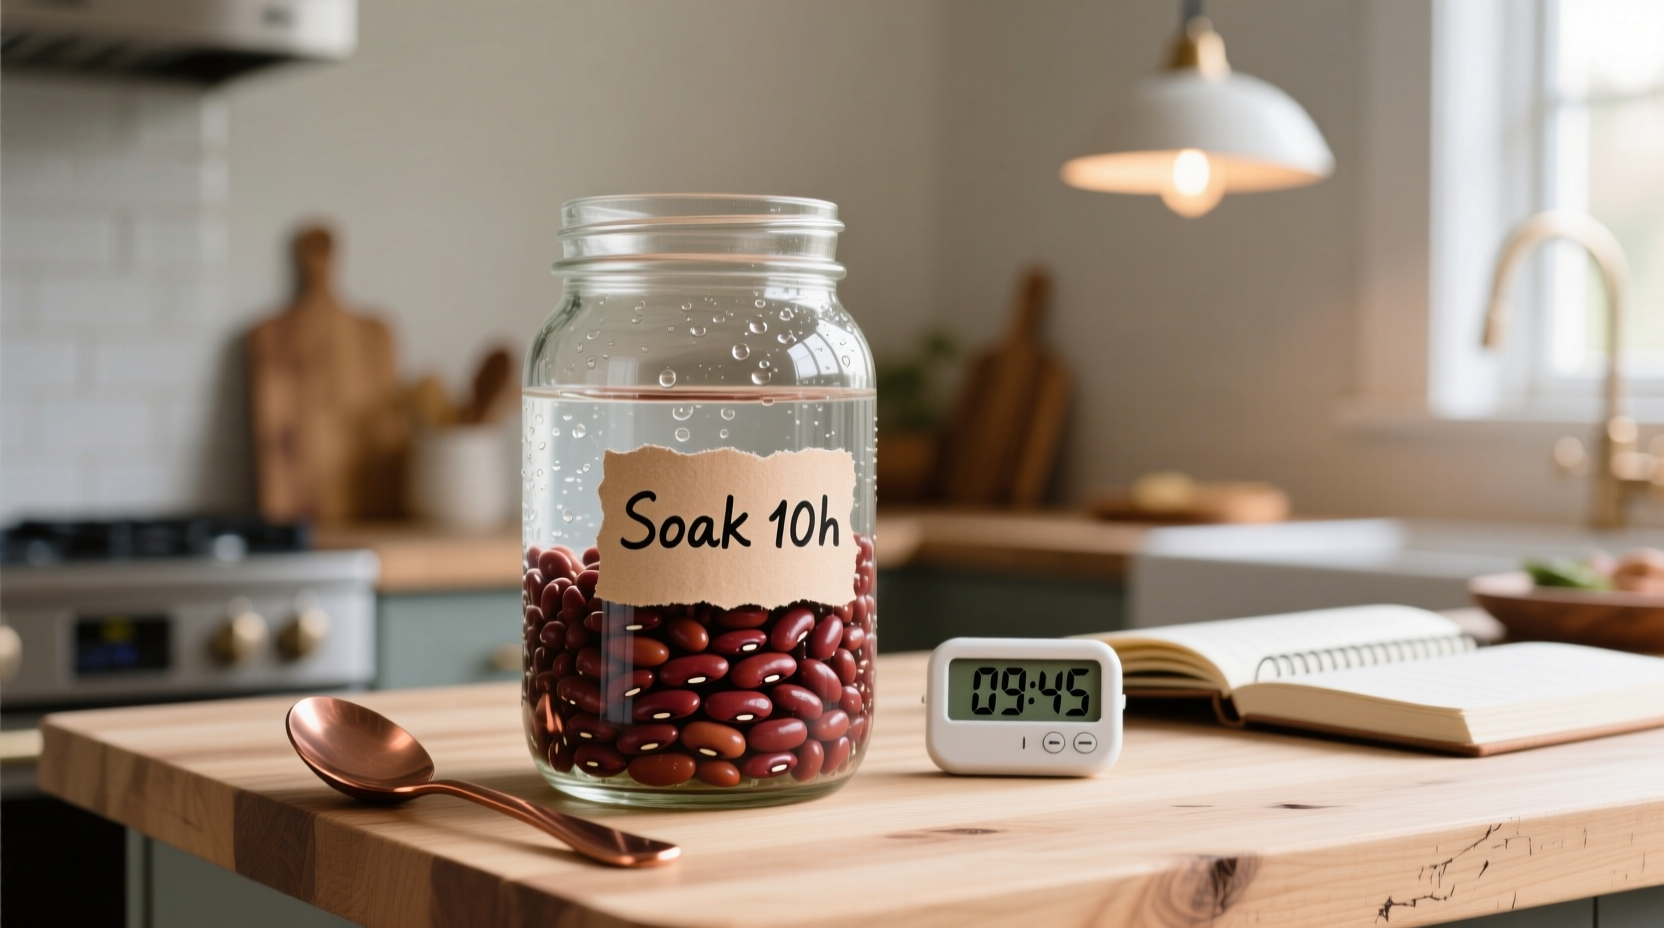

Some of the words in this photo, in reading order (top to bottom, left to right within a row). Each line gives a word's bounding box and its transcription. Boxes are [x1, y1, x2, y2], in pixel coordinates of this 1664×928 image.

[620, 491, 751, 550] Soak
[769, 494, 839, 549] 10h
[972, 667, 1089, 716] 09:45
